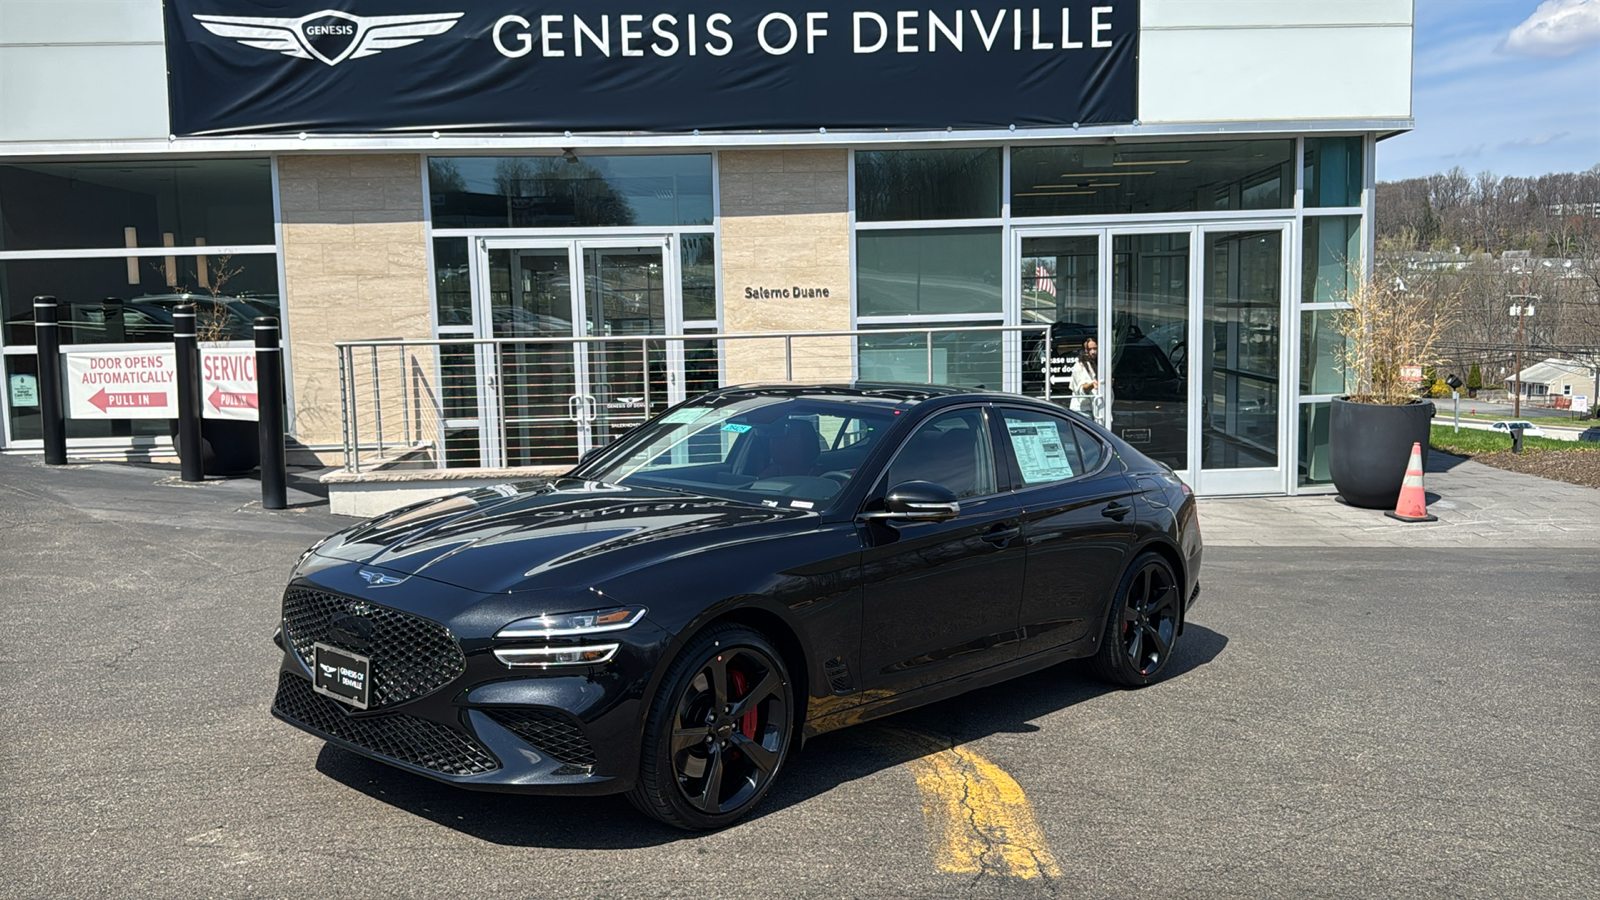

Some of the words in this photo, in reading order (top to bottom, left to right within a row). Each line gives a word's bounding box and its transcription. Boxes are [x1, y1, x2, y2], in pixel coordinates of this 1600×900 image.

[306, 25, 353, 35] GENESIS
[492, 12, 734, 59] GENESIS
[757, 11, 829, 55] OF
[852, 6, 1114, 54] DENVILLE
[744, 286, 791, 299] Salerno
[792, 286, 830, 299] Duane
[90, 357, 122, 369] DOOR
[124, 356, 163, 369] OPENS
[81, 370, 174, 384] AUTOMATICALLY
[108, 395, 135, 405] PULL
[138, 394, 150, 405] IN
[220, 393, 239, 406] PULL
